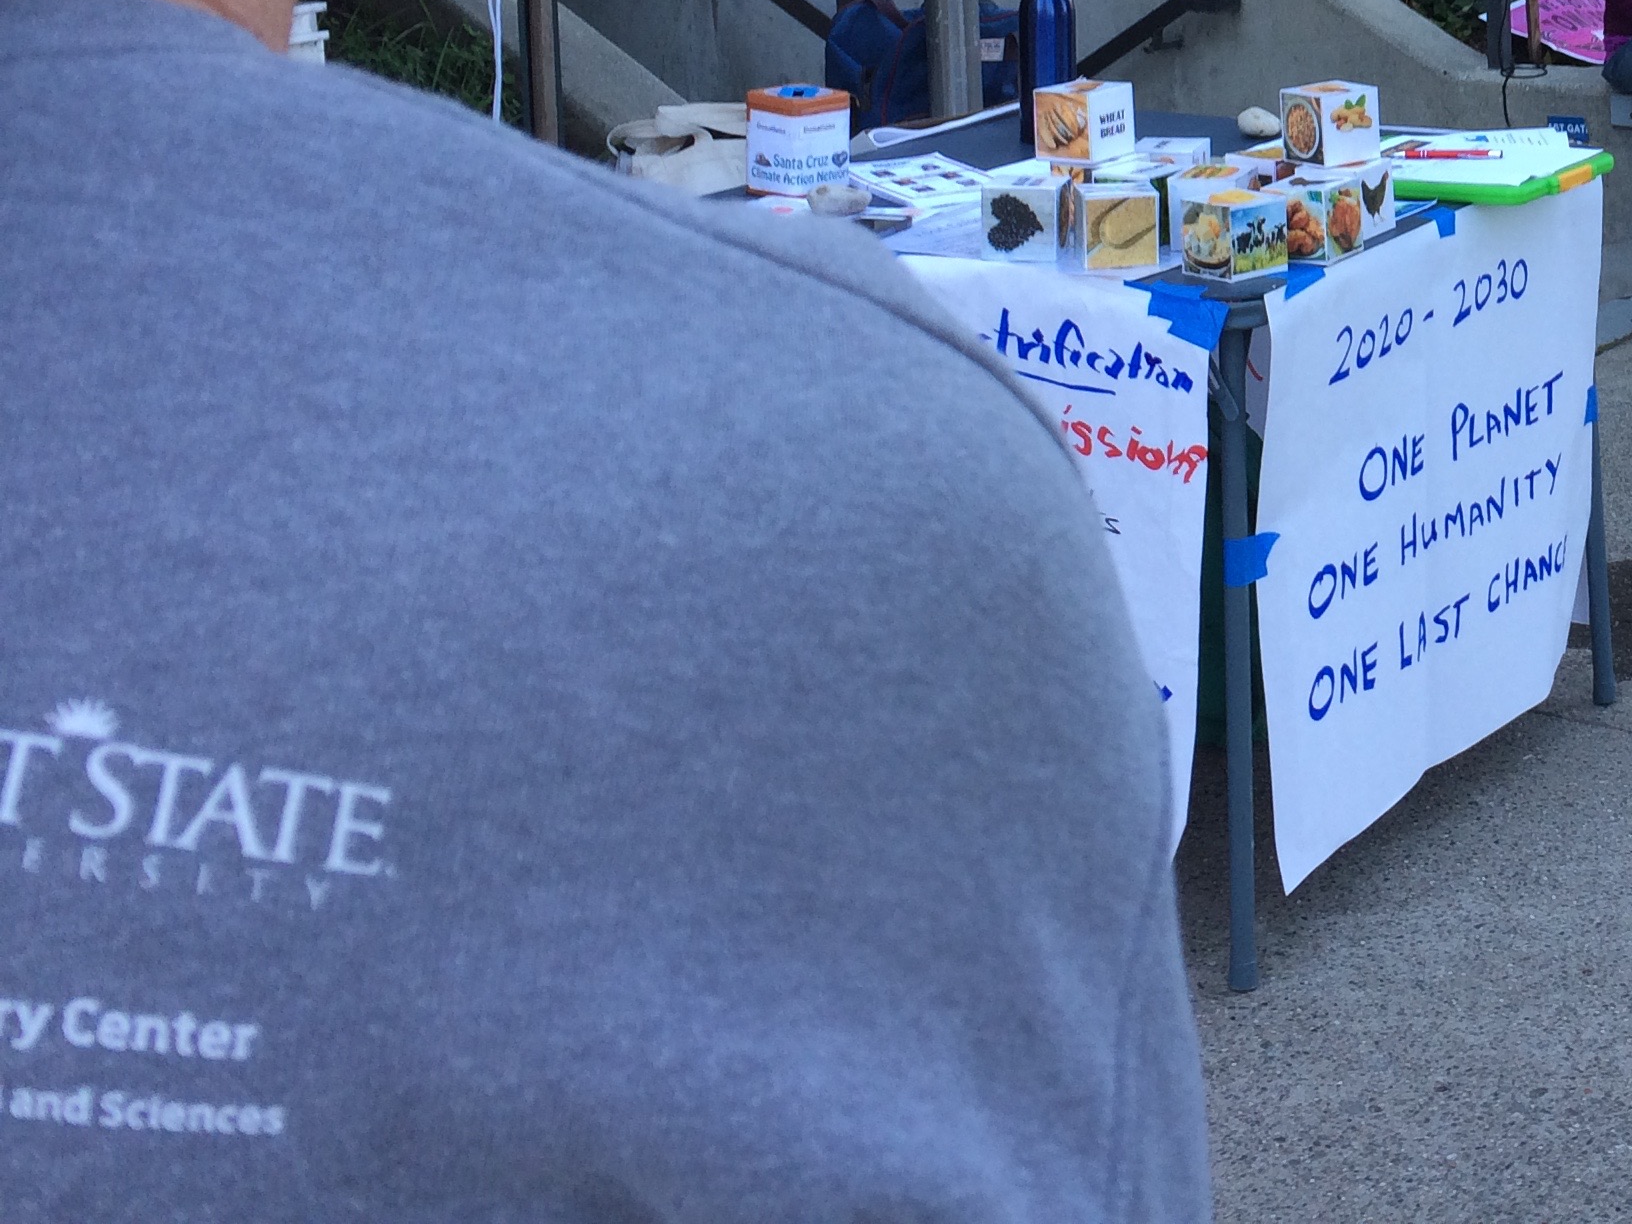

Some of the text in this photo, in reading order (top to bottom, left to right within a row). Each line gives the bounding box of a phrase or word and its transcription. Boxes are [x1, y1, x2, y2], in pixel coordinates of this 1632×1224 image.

[1099, 109, 1125, 125] WHEAT
[1100, 123, 1126, 139] BREAD
[773, 154, 828, 170] Santa Cruz
[783, 172, 814, 186] Action
[979, 307, 1194, 394] trification
[1329, 317, 1412, 385] 2020
[1453, 257, 1529, 327] 2030
[1358, 372, 1564, 502] ONE PLANET
[1307, 454, 1562, 620] ONE HUMANITY
[1307, 534, 1568, 722] ONE LAST CHANC
[69, 739, 393, 877] STATE
[62, 996, 261, 1062] Center
[9, 1085, 286, 1137] and Sciences
